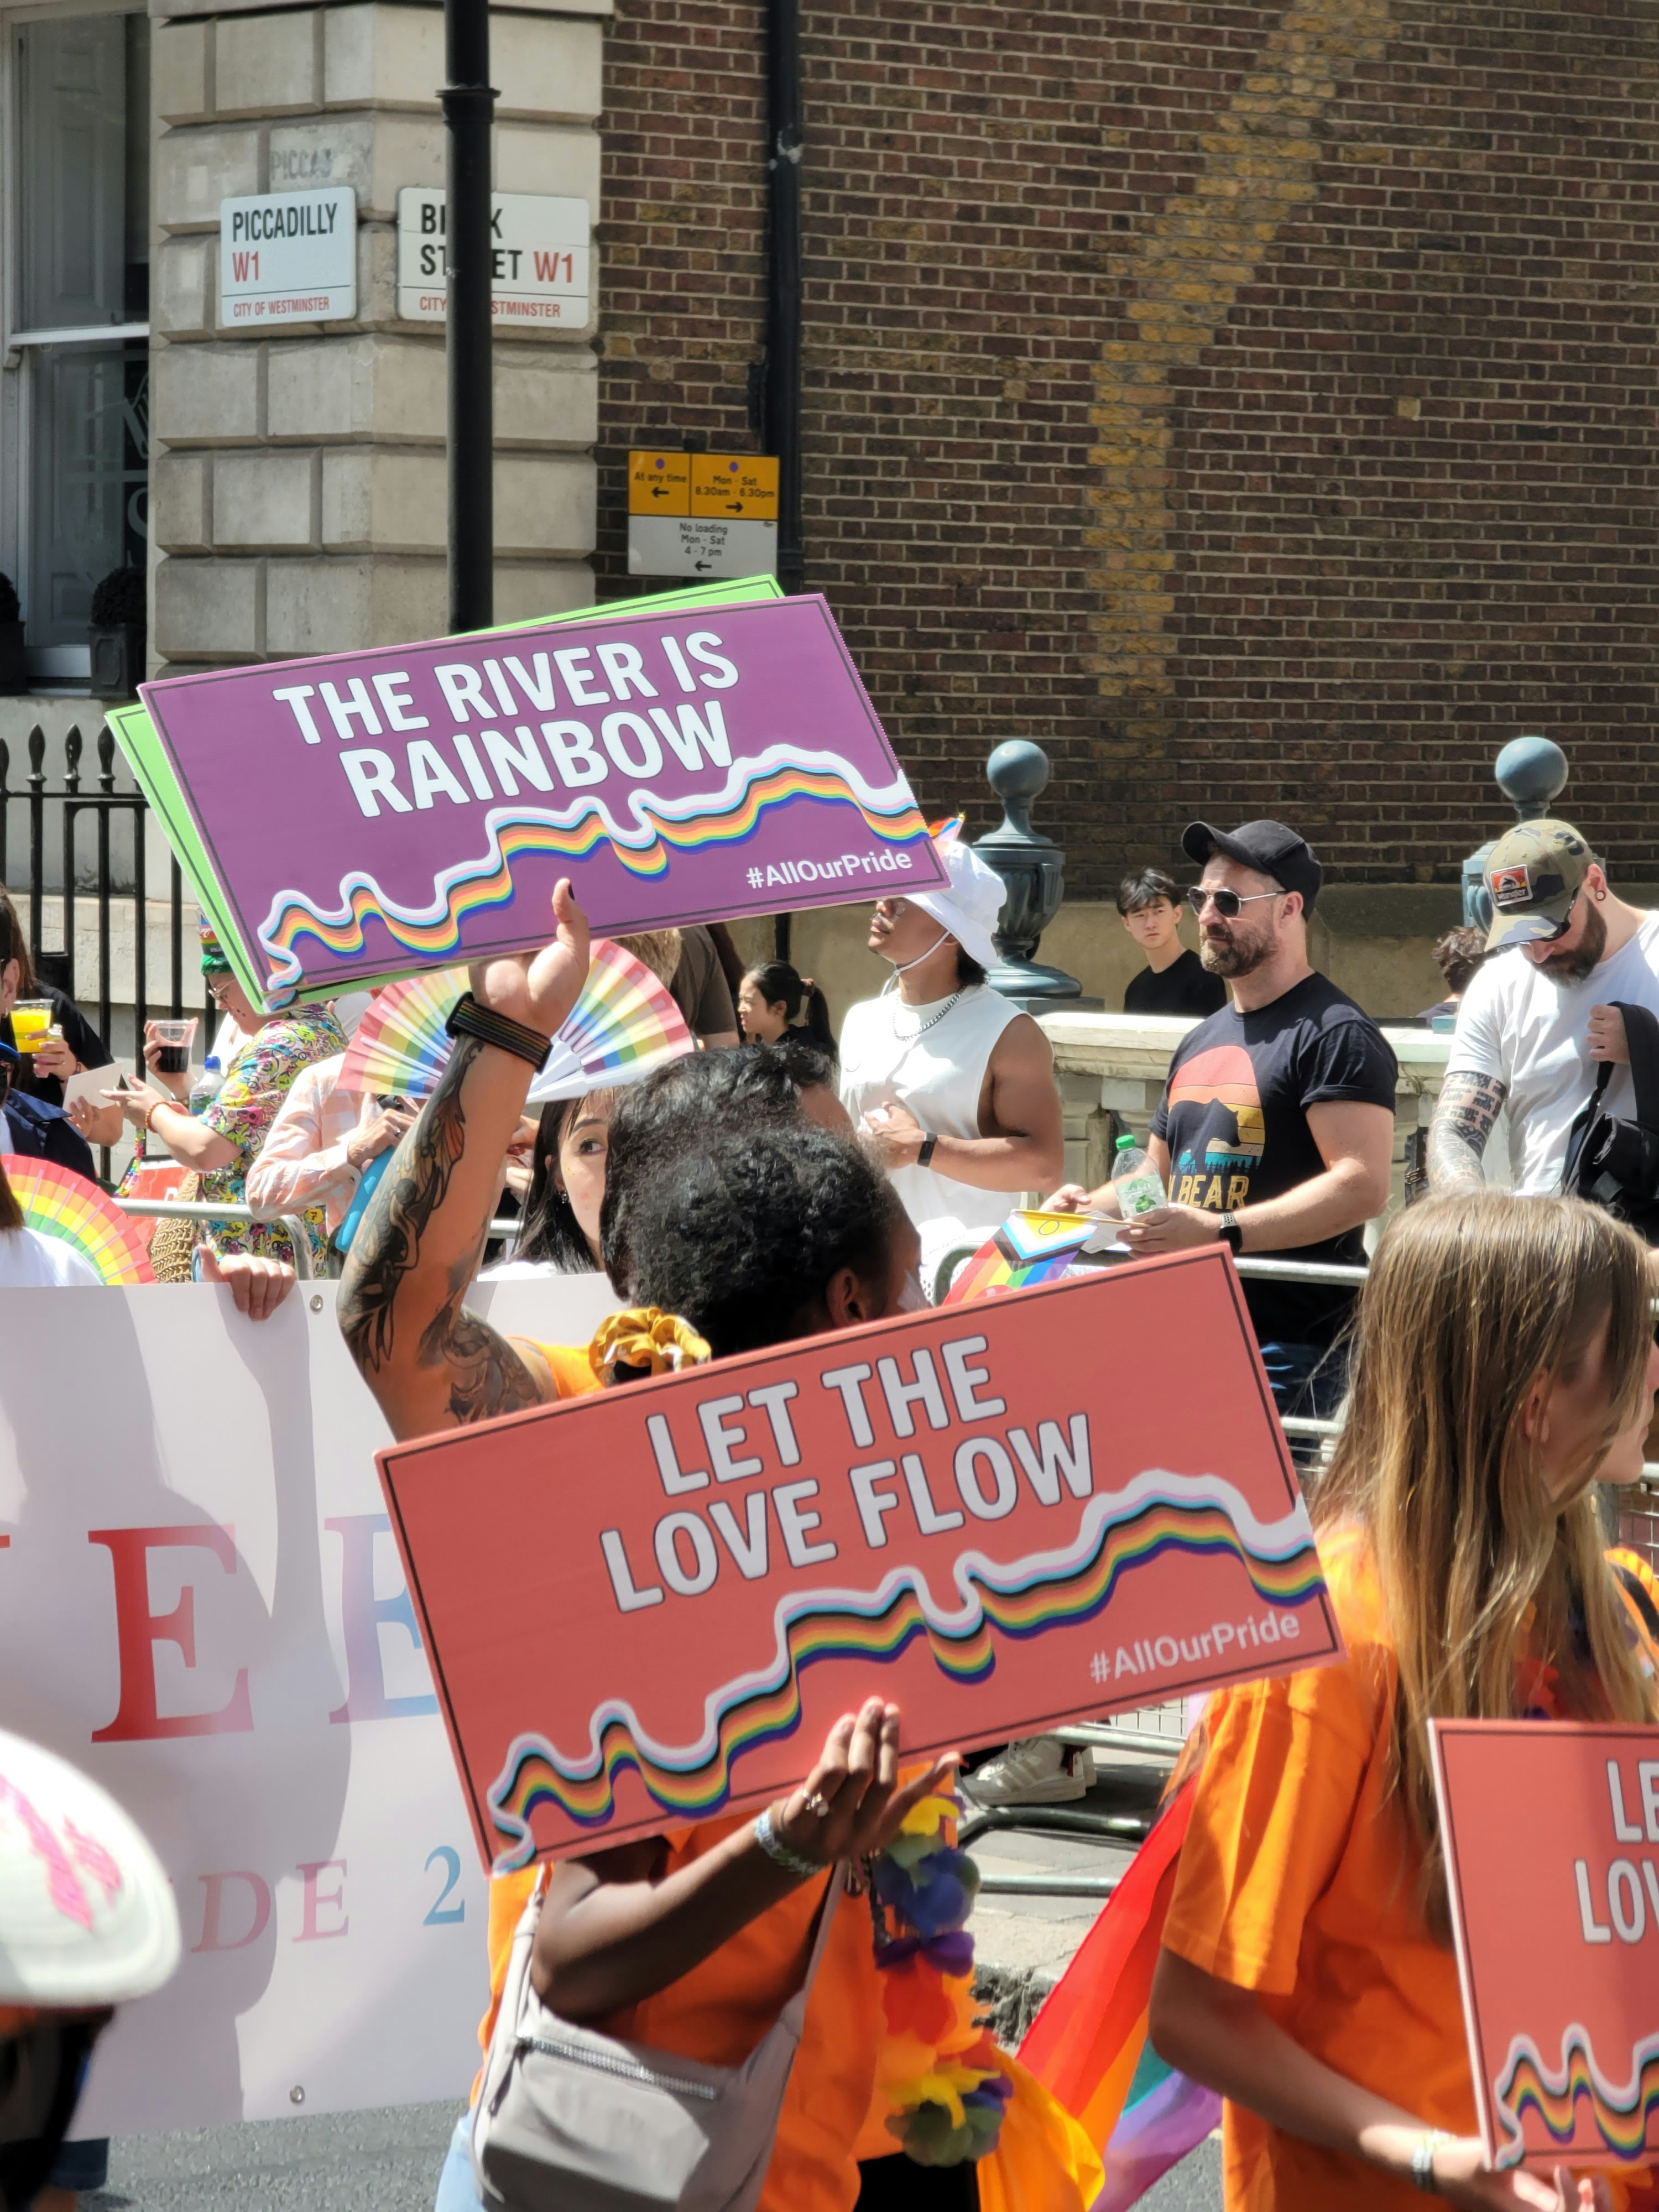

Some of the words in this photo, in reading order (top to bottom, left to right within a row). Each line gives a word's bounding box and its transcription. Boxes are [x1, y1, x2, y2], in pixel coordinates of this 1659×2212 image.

[233, 202, 337, 242] PICCADILLY
[232, 251, 259, 282] W1
[420, 244, 523, 280] STET
[534, 251, 572, 283] W1
[233, 302, 252, 317] CITY
[255, 301, 265, 316] OF
[268, 296, 330, 314] WESTMINSTER
[491, 300, 561, 317] STMINSTER
[634, 472, 645, 481] At
[648, 474, 663, 483] any
[667, 473, 687, 483] time
[695, 486, 730, 495] 8.30am
[739, 488, 775, 498] 6.30pm
[713, 476, 732, 484] Mon
[742, 477, 758, 486] Sat
[679, 523, 692, 531] No
[695, 524, 728, 535] loading
[681, 535, 700, 544] Mon
[709, 536, 726, 545] Sat
[685, 546, 691, 555] 4
[700, 546, 706, 555] 7
[708, 548, 722, 557] pm
[272, 671, 430, 745] THE
[434, 642, 659, 723] RIVER
[660, 630, 740, 693] IS
[338, 700, 734, 818] RAINBOW
[746, 849, 912, 889] #AllOurPride
[1177, 1175, 1249, 1210] BEAR
[645, 1381, 801, 1496] LET
[821, 1335, 1007, 1449] THE
[600, 1478, 837, 1613] LOVE
[848, 1412, 1093, 1549] FLOW
[1089, 1610, 1300, 1685] #AllOurPride
[1606, 1759, 1659, 1843] LE
